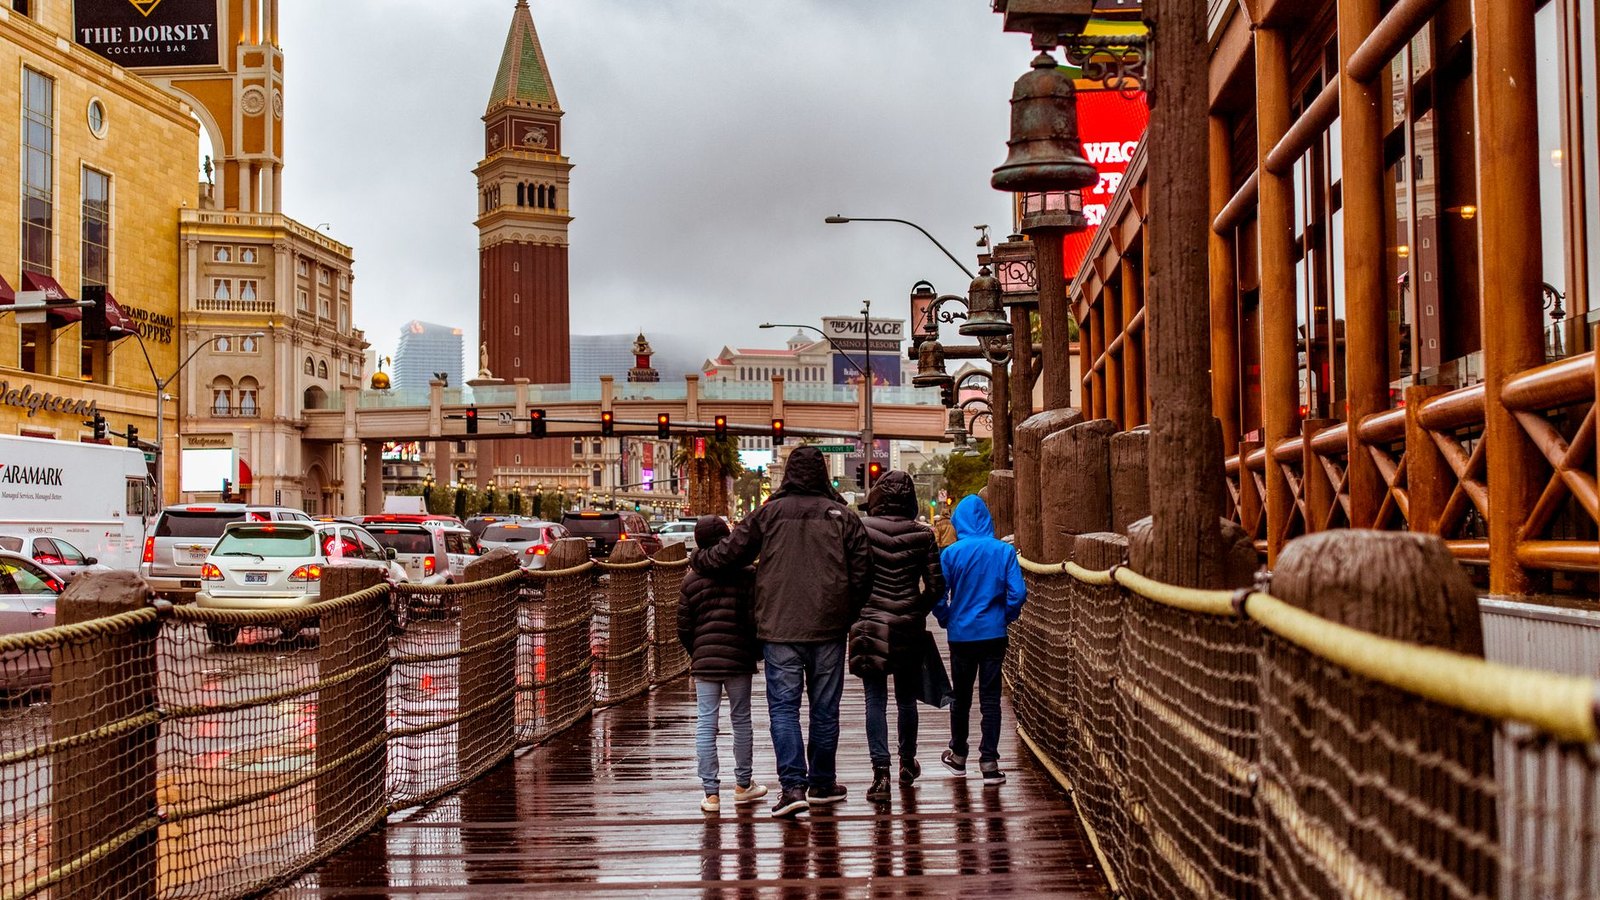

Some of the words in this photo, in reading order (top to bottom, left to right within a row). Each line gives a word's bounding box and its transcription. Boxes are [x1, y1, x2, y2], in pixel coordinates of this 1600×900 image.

[81, 27, 122, 44] THE
[129, 24, 212, 43] DORSEY
[107, 45, 160, 54] COCKTAIL
[121, 305, 149, 321] GRAND
[150, 312, 175, 328] CANAL
[134, 321, 172, 344] OPPES
[835, 322, 901, 335] MIRAGE
[869, 341, 899, 349] RESORT
[2, 465, 63, 486] ARAMARK
